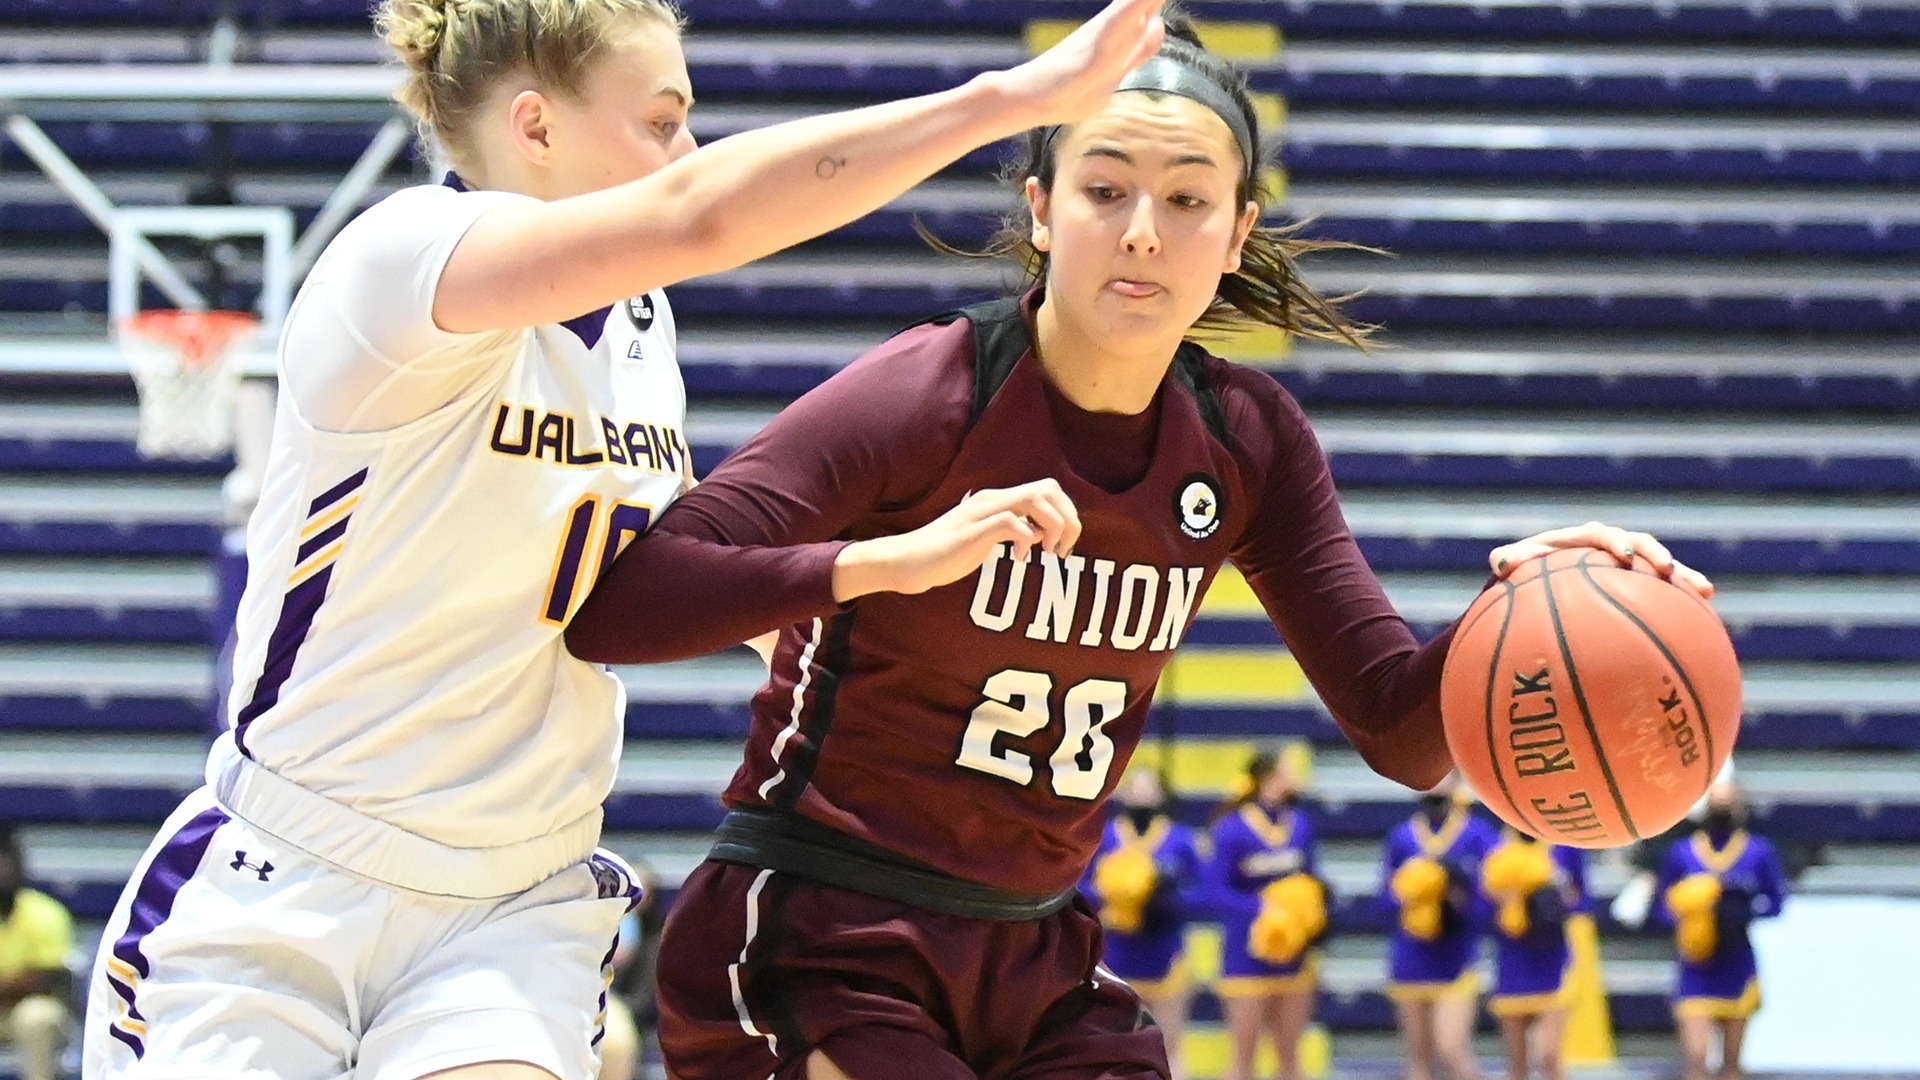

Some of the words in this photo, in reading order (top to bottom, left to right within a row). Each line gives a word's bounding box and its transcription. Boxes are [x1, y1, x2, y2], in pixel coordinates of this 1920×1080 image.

[490, 402, 685, 475] UALBANY
[969, 543, 1205, 651] UNION
[955, 669, 1127, 800] 20
[1509, 667, 1576, 778] ROCK
